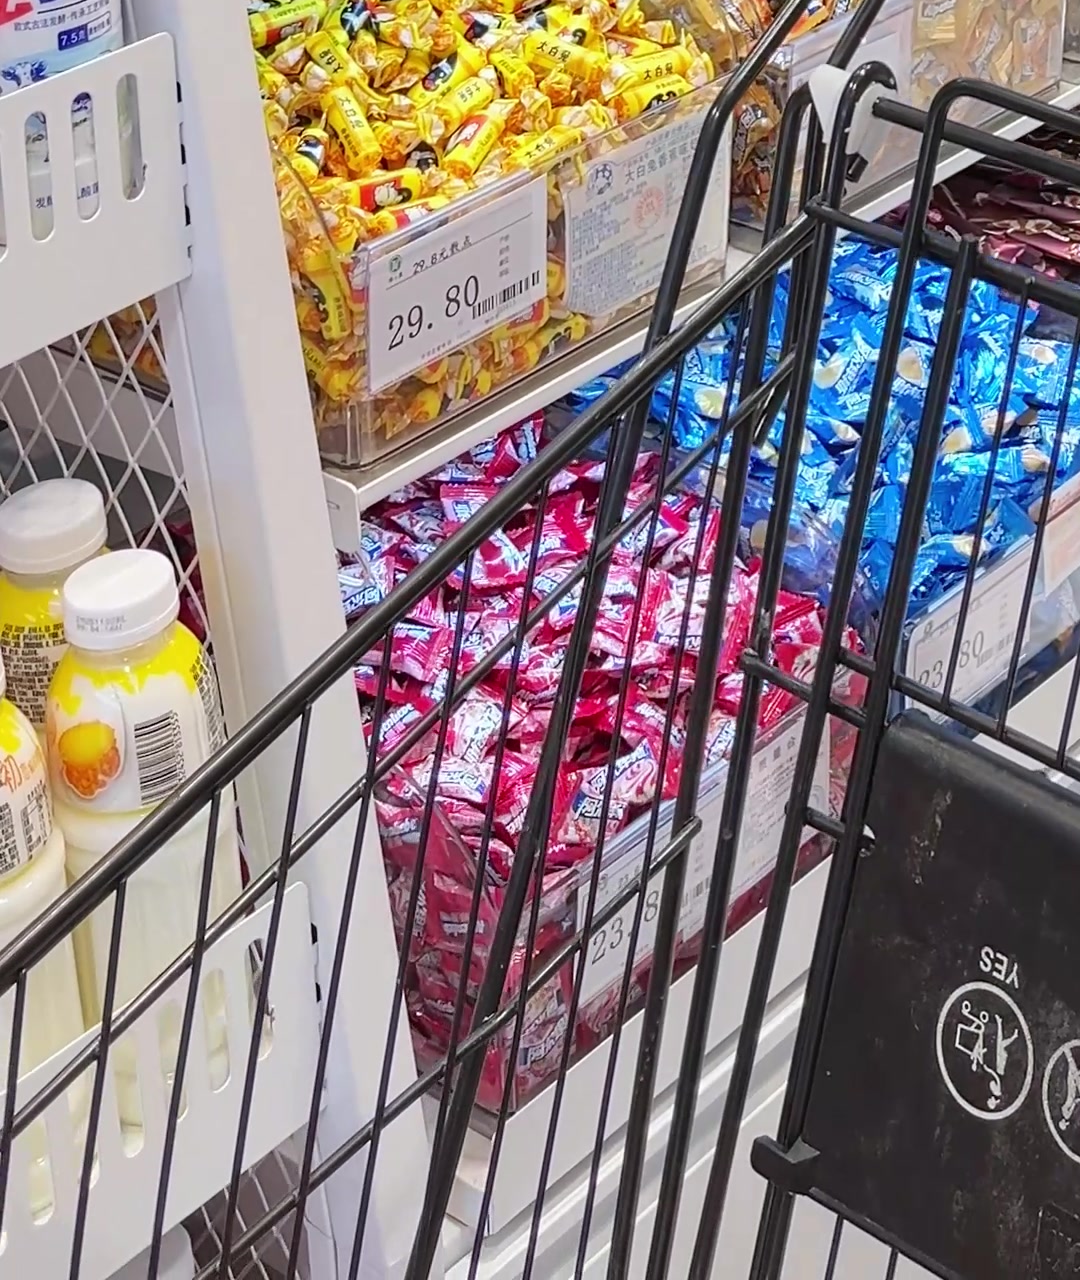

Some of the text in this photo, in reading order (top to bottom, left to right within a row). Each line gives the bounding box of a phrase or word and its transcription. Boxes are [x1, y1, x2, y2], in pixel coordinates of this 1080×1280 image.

[536, 39, 572, 63] 大白兔
[643, 61, 675, 81] 大白兔
[524, 136, 556, 160] 大白兔
[387, 274, 480, 351] 29.80
[978, 945, 1020, 990] YES
